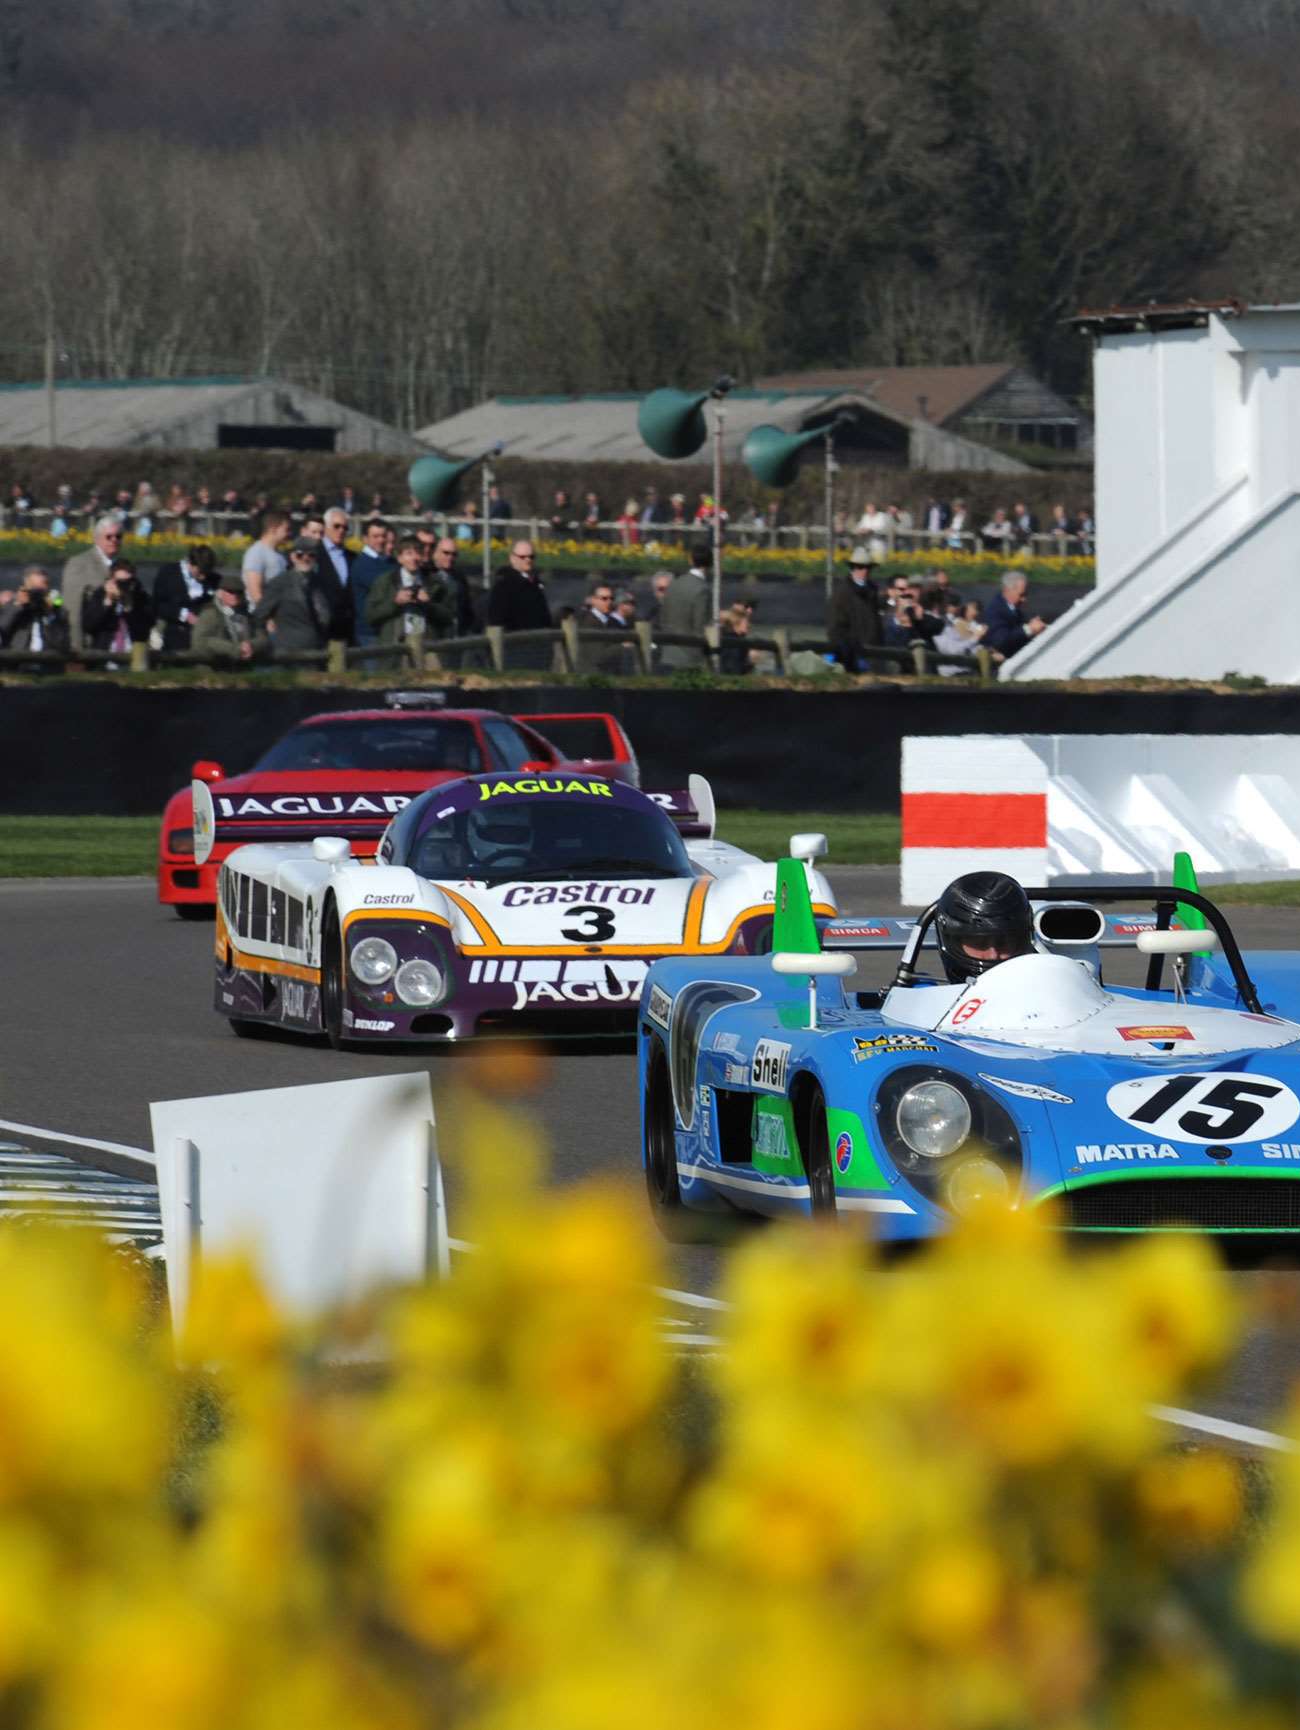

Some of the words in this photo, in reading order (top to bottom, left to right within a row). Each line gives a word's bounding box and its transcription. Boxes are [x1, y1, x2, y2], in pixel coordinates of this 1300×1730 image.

[479, 779, 613, 801] JAGUAR
[363, 893, 415, 905] Castrol
[502, 882, 656, 907] Castrol
[561, 905, 616, 943] 3
[830, 927, 881, 936] SIMCA
[354, 1018, 395, 1032] DUNLOP
[753, 1043, 789, 1089] Shell
[1128, 1075, 1284, 1140] 15
[1075, 1143, 1180, 1164] MATRA
